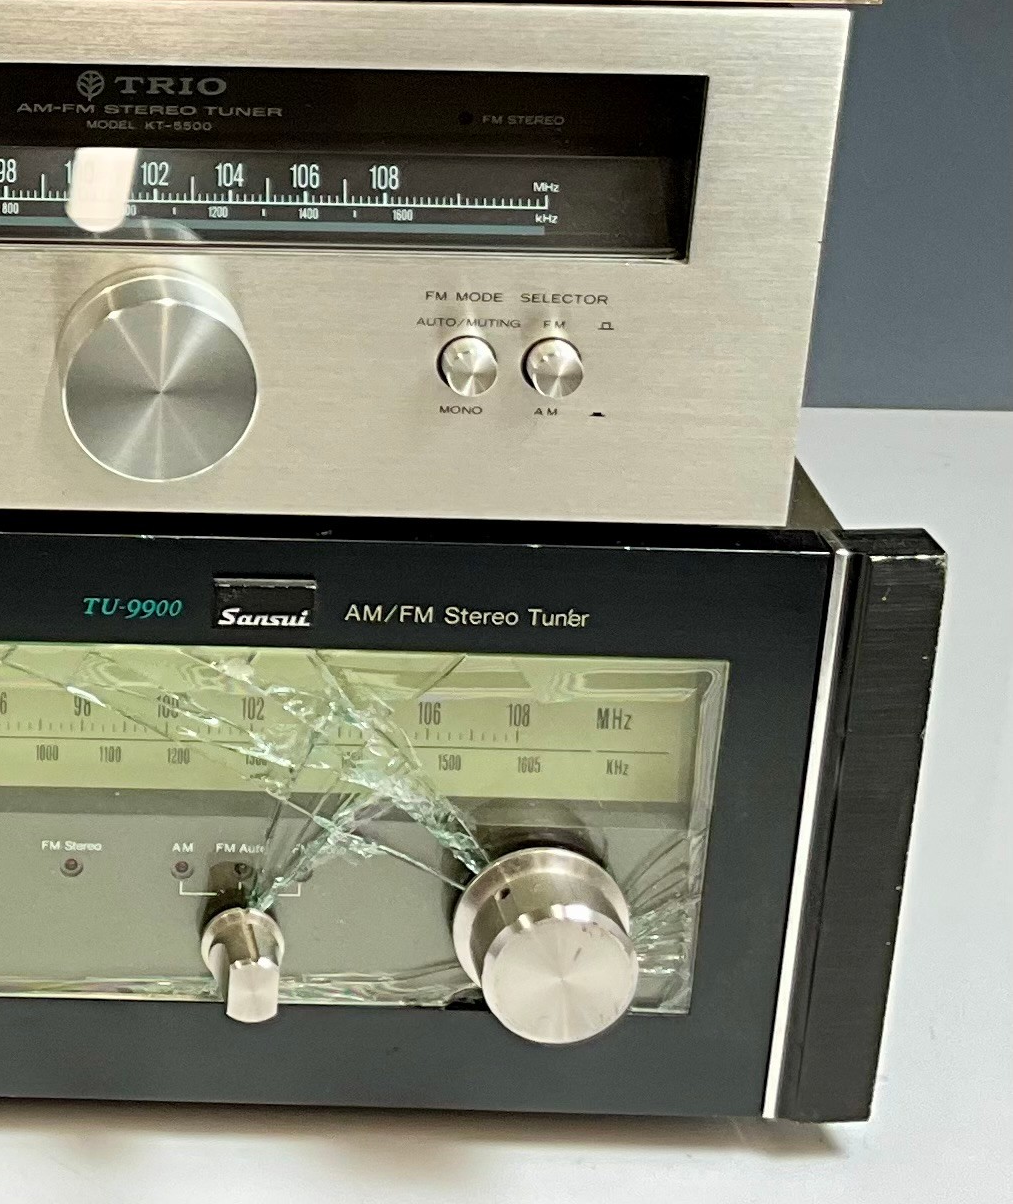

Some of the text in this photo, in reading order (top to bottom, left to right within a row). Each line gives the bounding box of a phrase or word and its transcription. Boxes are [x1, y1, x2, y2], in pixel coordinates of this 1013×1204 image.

[114, 76, 228, 96] TRIO
[16, 102, 283, 118] AM-FM STEREO TUNER
[86, 120, 212, 132] MODEL KT-5500
[481, 114, 566, 127] FM STEREO
[140, 161, 170, 187] 102
[214, 162, 245, 188] 104
[289, 163, 320, 189] 106
[369, 165, 400, 190] 108
[532, 180, 560, 193] MHz
[207, 205, 229, 219] 1200
[298, 206, 319, 220] 1400
[391, 208, 414, 222] 1600
[534, 212, 559, 225] kHz
[425, 290, 504, 303] FM MODE
[520, 292, 609, 306] SELECTOR
[415, 316, 522, 329] AUTO/MUTING
[542, 319, 567, 330] FM
[439, 405, 484, 416] MONO
[533, 407, 558, 417] AM
[82, 596, 184, 618] TU-9900
[217, 607, 311, 628] Sansui
[344, 603, 591, 629] AM/FM Stereo Tuner
[241, 696, 266, 721] 102
[417, 701, 442, 727] 106
[507, 703, 531, 728] 108
[596, 707, 633, 731] MHz
[35, 744, 60, 762] 1000
[98, 745, 122, 764] 1100
[166, 746, 191, 766] 1200
[437, 753, 462, 772] 1500
[605, 758, 629, 777] KHz
[40, 840, 103, 852] FM Stereo
[171, 842, 195, 854] AM
[215, 843, 237, 854] FM
